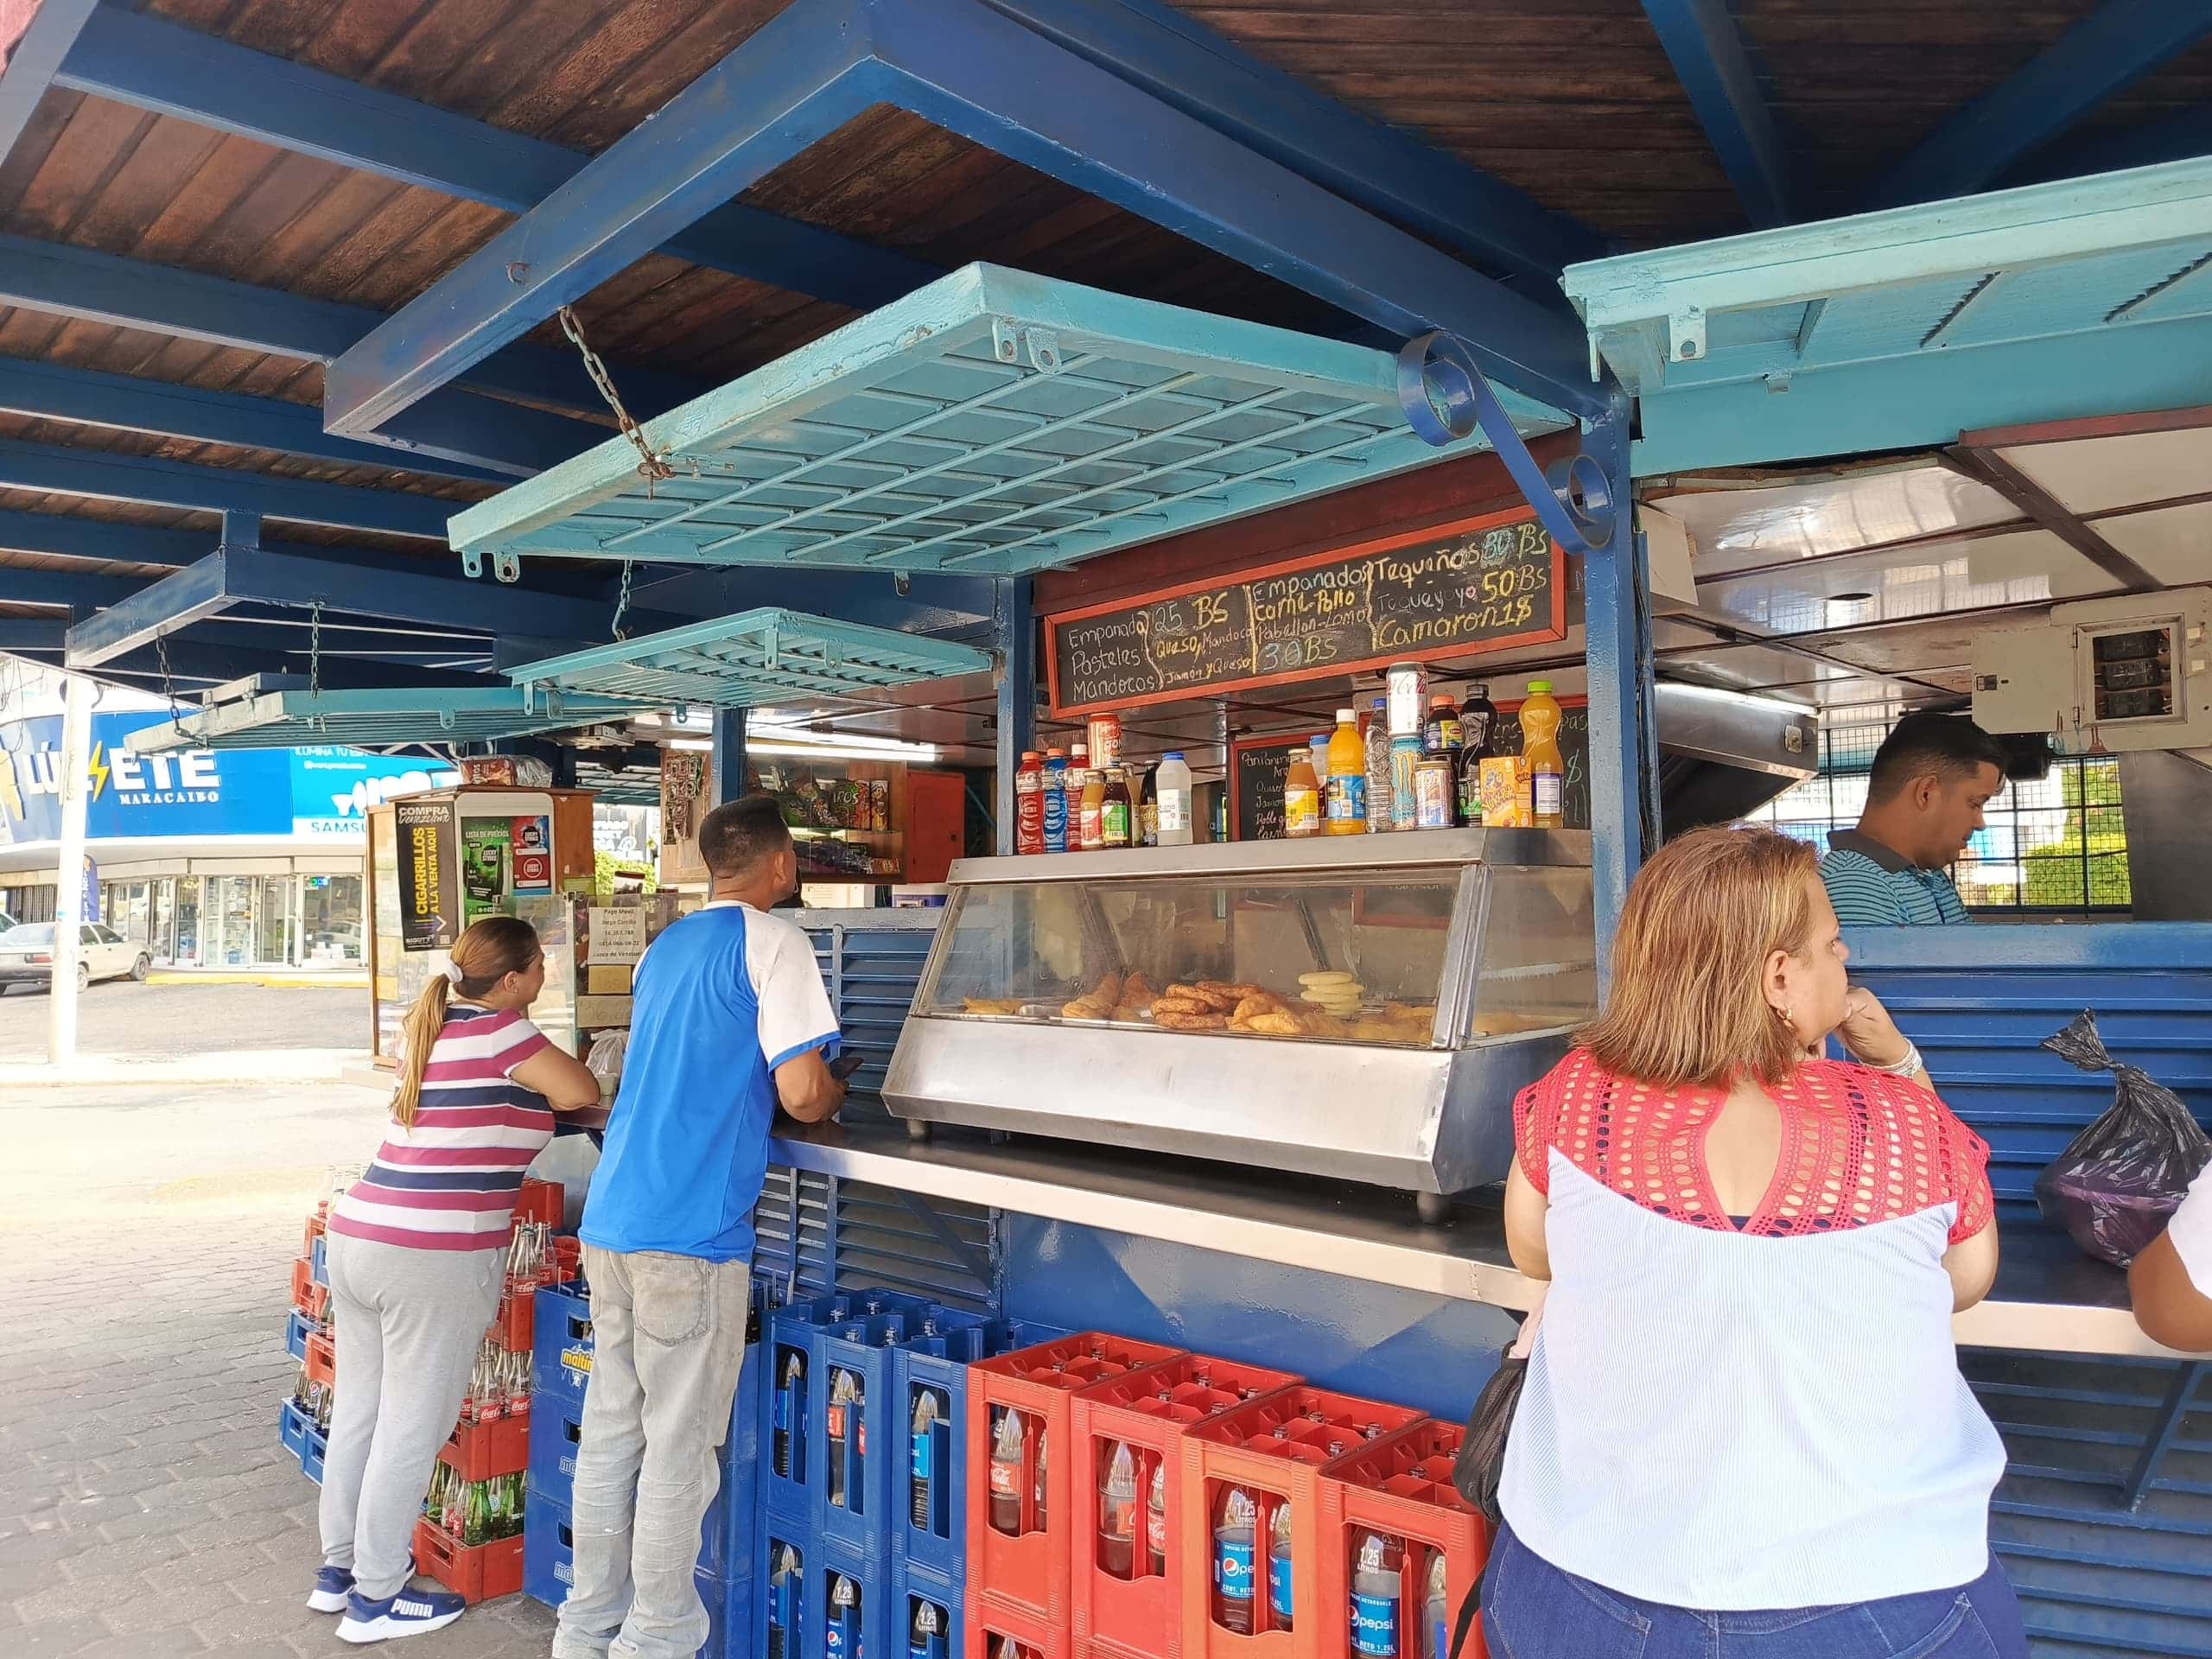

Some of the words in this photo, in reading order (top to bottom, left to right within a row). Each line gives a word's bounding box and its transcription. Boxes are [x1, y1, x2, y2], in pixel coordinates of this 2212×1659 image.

[1482, 569, 1515, 603] 50
[1155, 603, 1182, 632] 25
[1071, 646, 1141, 676] Pasteles
[119, 791, 219, 804] MARACAIBO
[398, 807, 449, 816] COMPRA
[413, 827, 428, 914] CIGARRILLOS
[429, 854, 438, 889] VENTA
[429, 890, 439, 904] LA
[1237, 1501, 1255, 1516] 1.25
[1360, 1547, 1379, 1566] 1.25
[1357, 1563, 1379, 1573] LITROS
[391, 1599, 434, 1618] PUMA
[1359, 1617, 1394, 1630] pepsi
